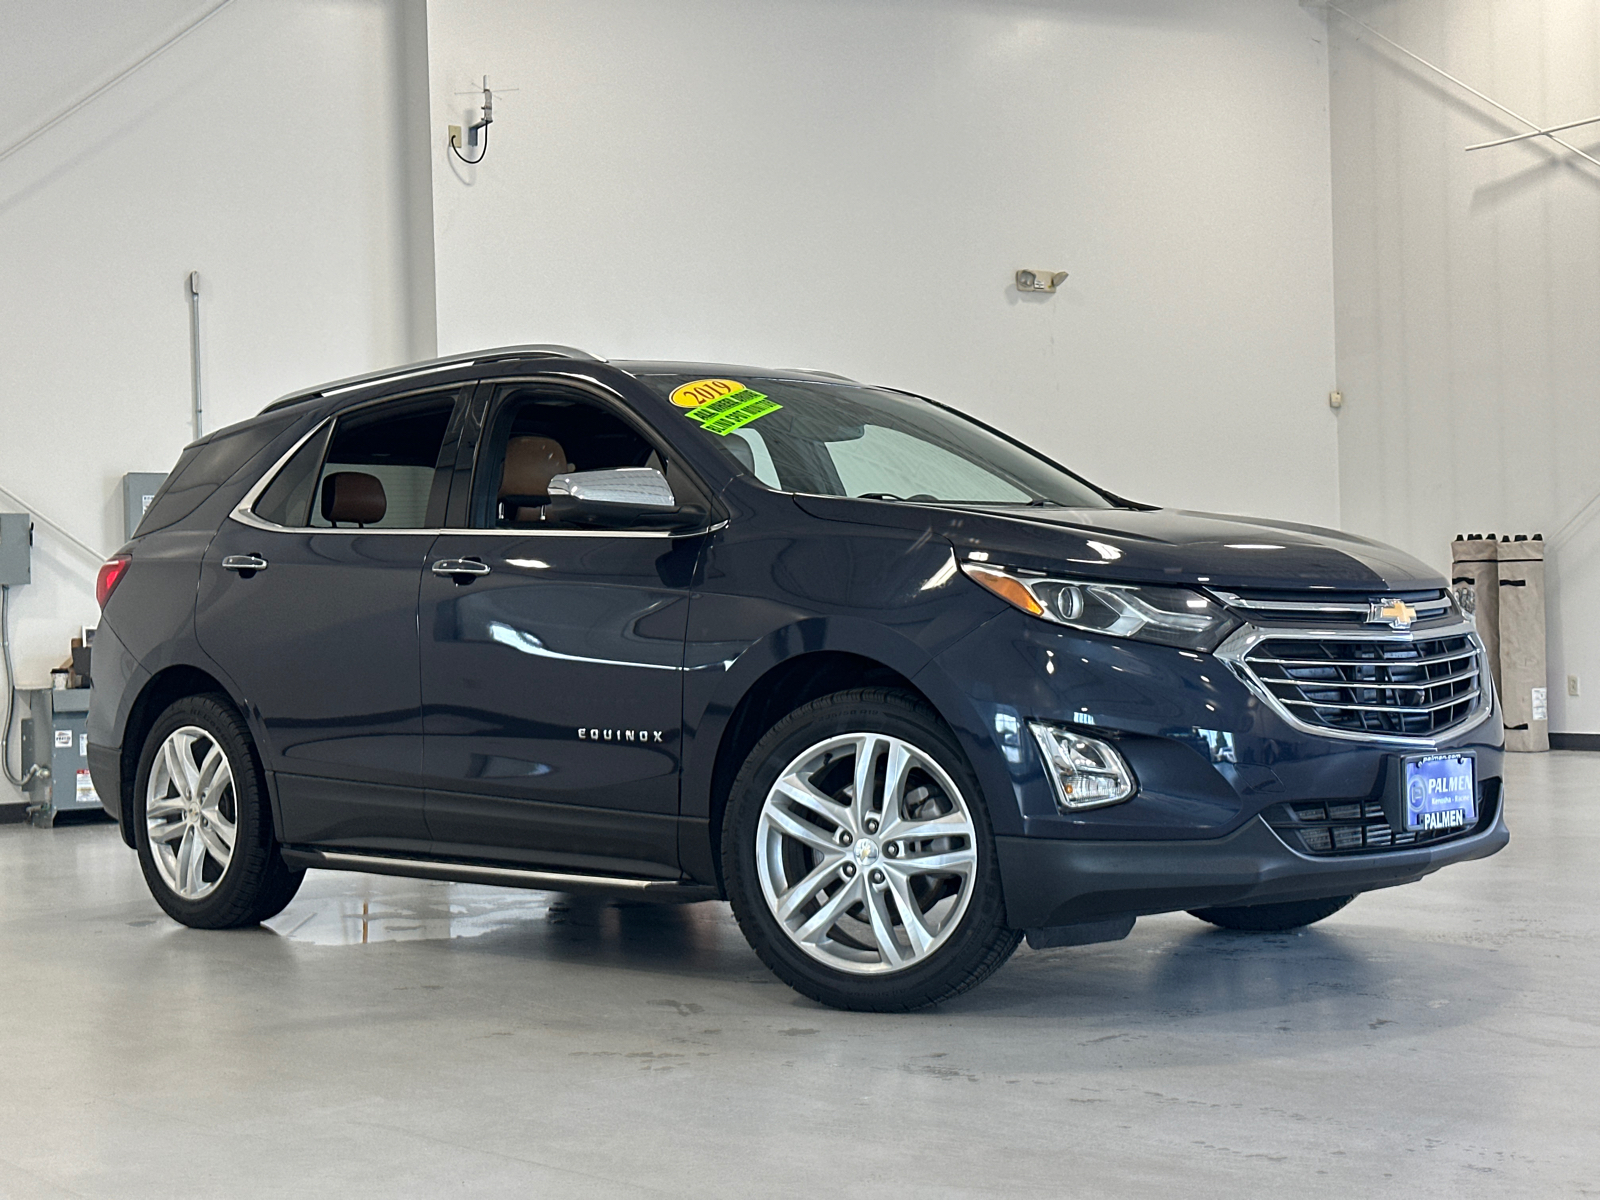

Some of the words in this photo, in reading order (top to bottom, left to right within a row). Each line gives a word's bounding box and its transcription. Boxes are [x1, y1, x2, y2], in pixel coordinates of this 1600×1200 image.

[683, 381, 731, 404] 2019
[693, 409, 719, 422] ALL
[577, 727, 663, 743] EQUINOX
[1428, 775, 1471, 794] PALMEN
[1424, 809, 1463, 830] PALMEN
